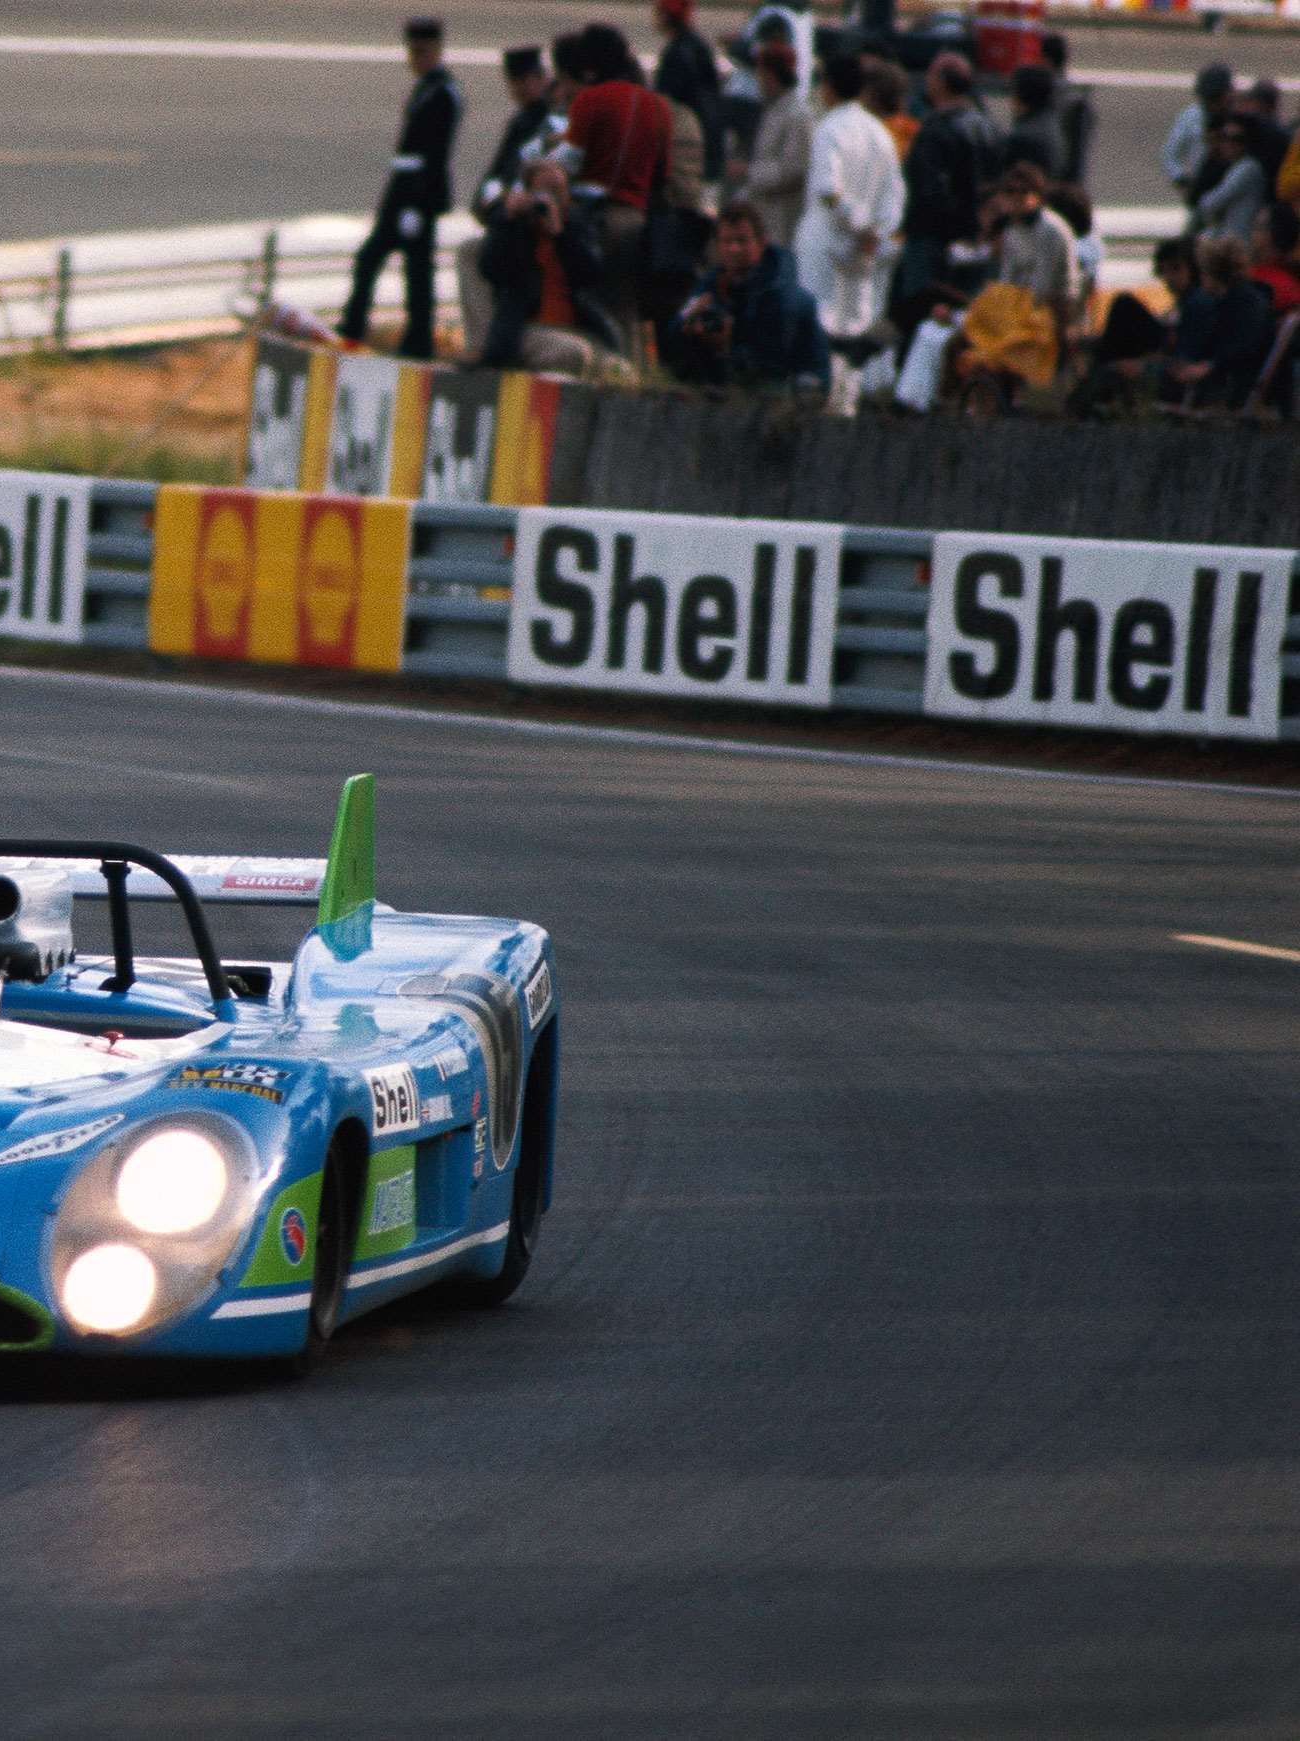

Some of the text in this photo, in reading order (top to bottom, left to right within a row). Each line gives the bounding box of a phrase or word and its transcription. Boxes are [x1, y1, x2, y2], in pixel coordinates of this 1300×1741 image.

[530, 525, 817, 685] Shell
[948, 550, 1263, 717] Shell
[235, 875, 306, 888] SIMCA
[371, 1070, 417, 1129] Shell
